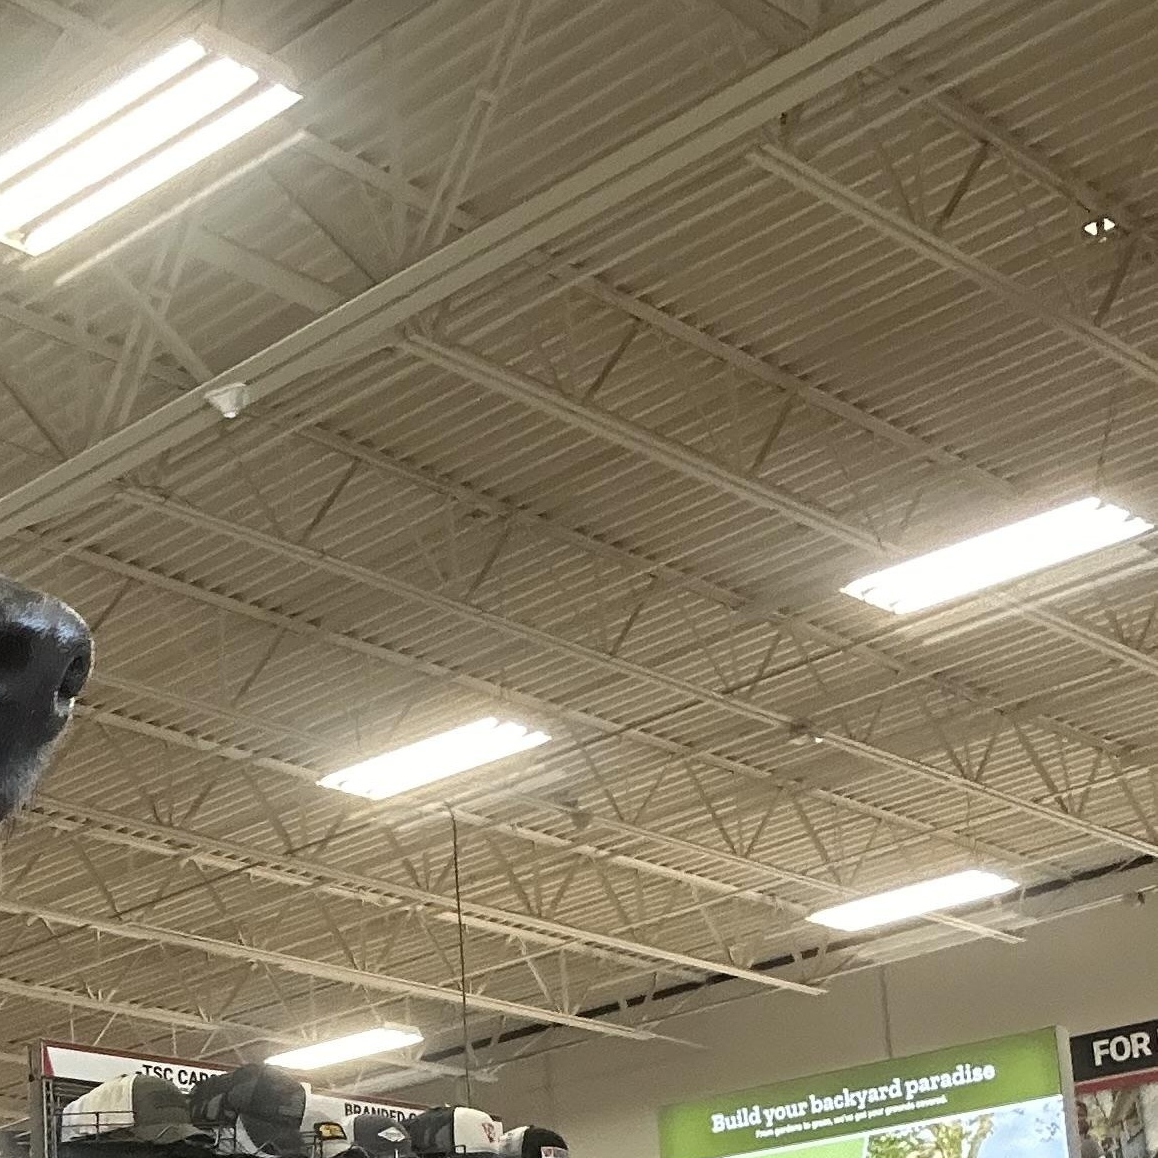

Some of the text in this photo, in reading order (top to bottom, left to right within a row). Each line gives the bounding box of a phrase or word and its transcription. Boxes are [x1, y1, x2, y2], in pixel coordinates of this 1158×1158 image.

[1092, 1031, 1153, 1067] FOR
[142, 1064, 217, 1085] TSC CAP
[344, 1102, 406, 1122] BRANDED
[711, 1063, 996, 1134] Build your backyard paradise
